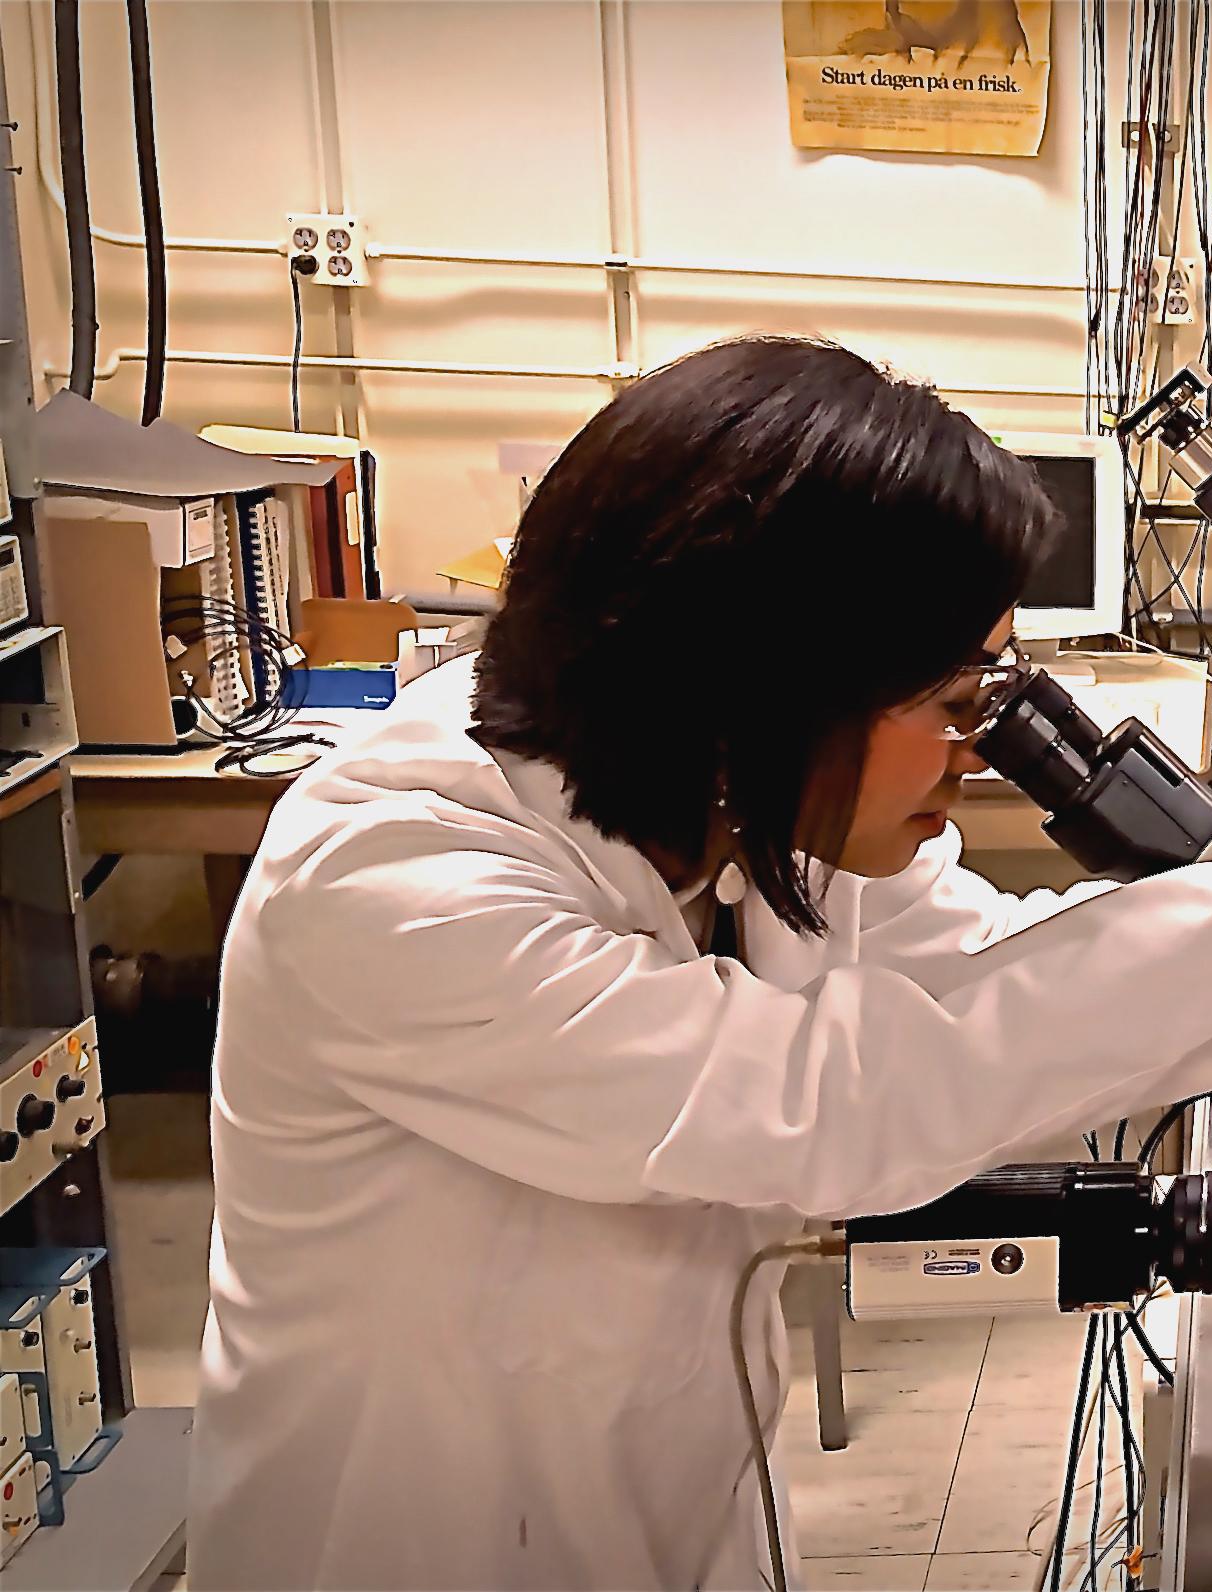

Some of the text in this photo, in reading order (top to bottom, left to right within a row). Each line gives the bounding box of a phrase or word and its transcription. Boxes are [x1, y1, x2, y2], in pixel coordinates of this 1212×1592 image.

[821, 66, 1022, 93] Start dagen på en frisk.
